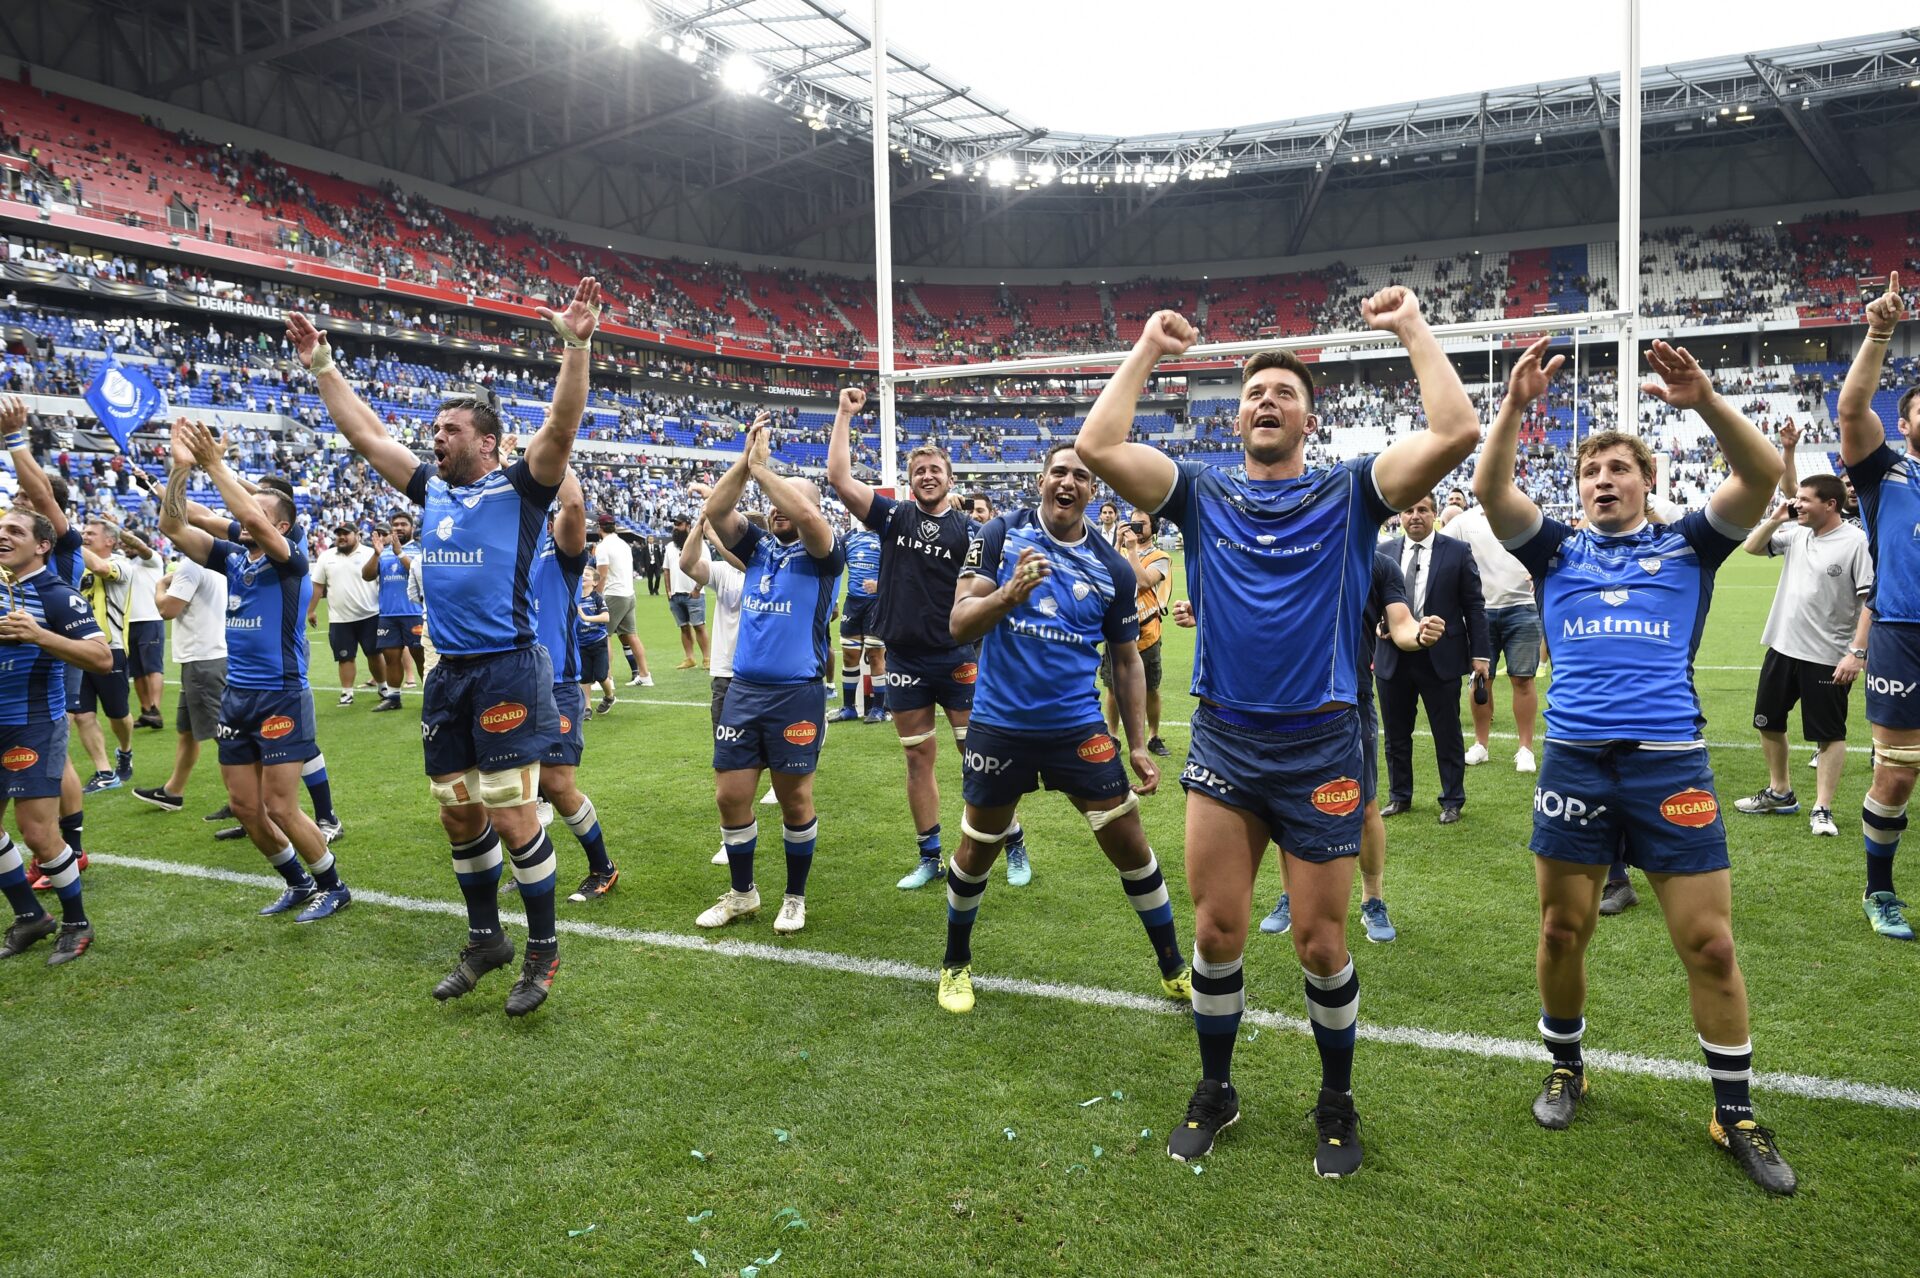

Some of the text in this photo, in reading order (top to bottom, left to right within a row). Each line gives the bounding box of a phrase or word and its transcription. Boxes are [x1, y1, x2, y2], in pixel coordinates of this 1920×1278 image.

[199, 296, 280, 320] DEMI-FINALE
[768, 386, 811, 397] DEMI-FINALE
[897, 535, 951, 560] KIPSTA
[1270, 542, 1322, 555] Fabre
[743, 594, 793, 613] Matmut
[226, 616, 262, 628] atmut
[1563, 615, 1671, 639] Matmut
[1867, 673, 1917, 698] HOP!
[482, 709, 524, 725] BIGARD
[216, 723, 240, 740] OP!
[261, 721, 292, 733] BIGARD
[716, 725, 746, 742] OP!
[786, 728, 817, 738] BIGARD
[1080, 740, 1114, 757] BIGARD
[489, 753, 518, 762] KIPSTA
[964, 747, 1013, 776] HOP!
[1316, 788, 1359, 804] BIGARD
[1534, 786, 1607, 826] HOP!
[1664, 800, 1716, 817] BIGARD
